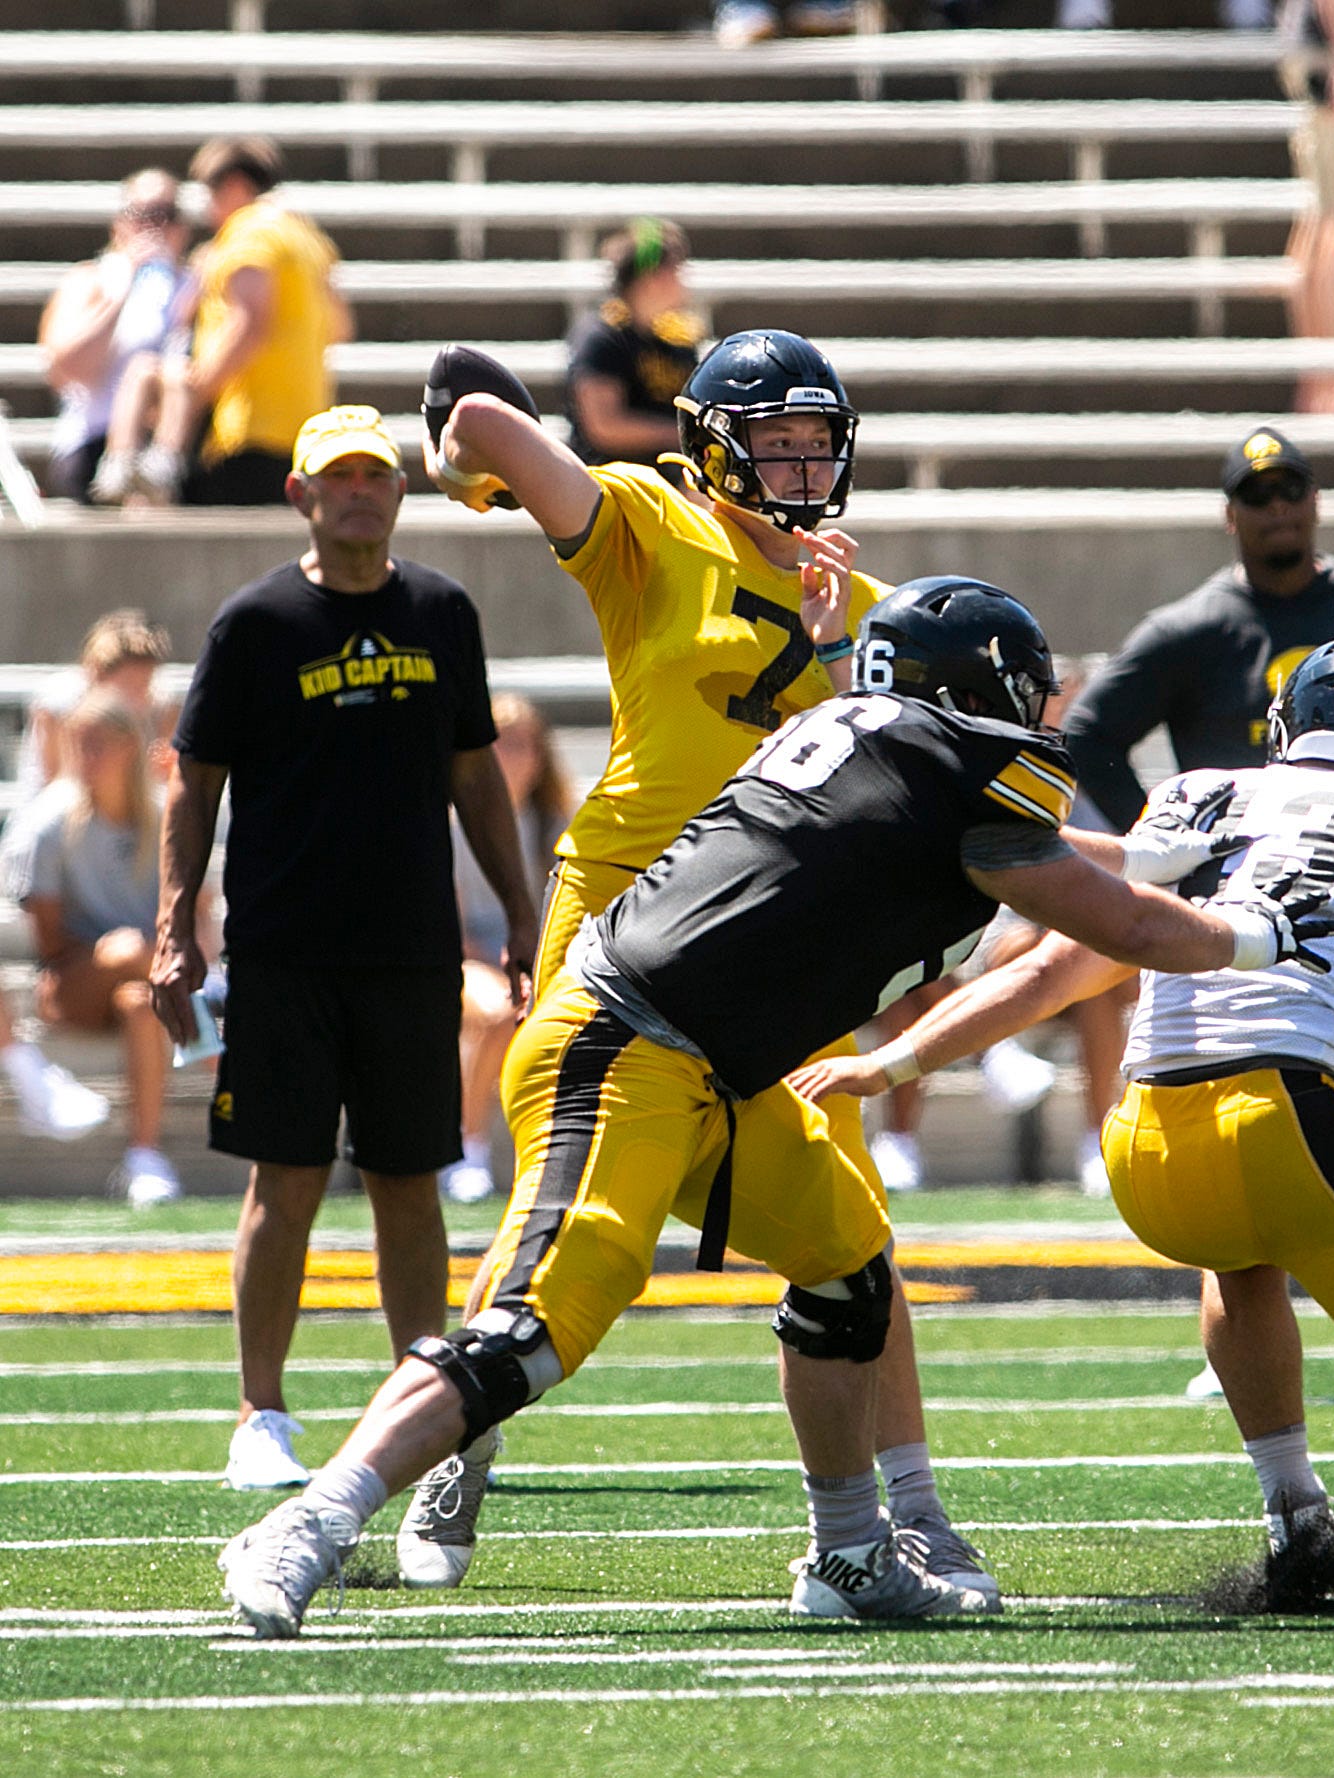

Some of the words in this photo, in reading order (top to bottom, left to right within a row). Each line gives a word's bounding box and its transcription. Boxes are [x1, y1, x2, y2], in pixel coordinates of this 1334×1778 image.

[804, 390, 825, 399] IOWA
[299, 664, 343, 700] KID
[344, 655, 437, 688] CAPTAIN
[726, 586, 815, 732] 7
[851, 639, 895, 692] 6
[808, 1551, 875, 1595] NIKE
